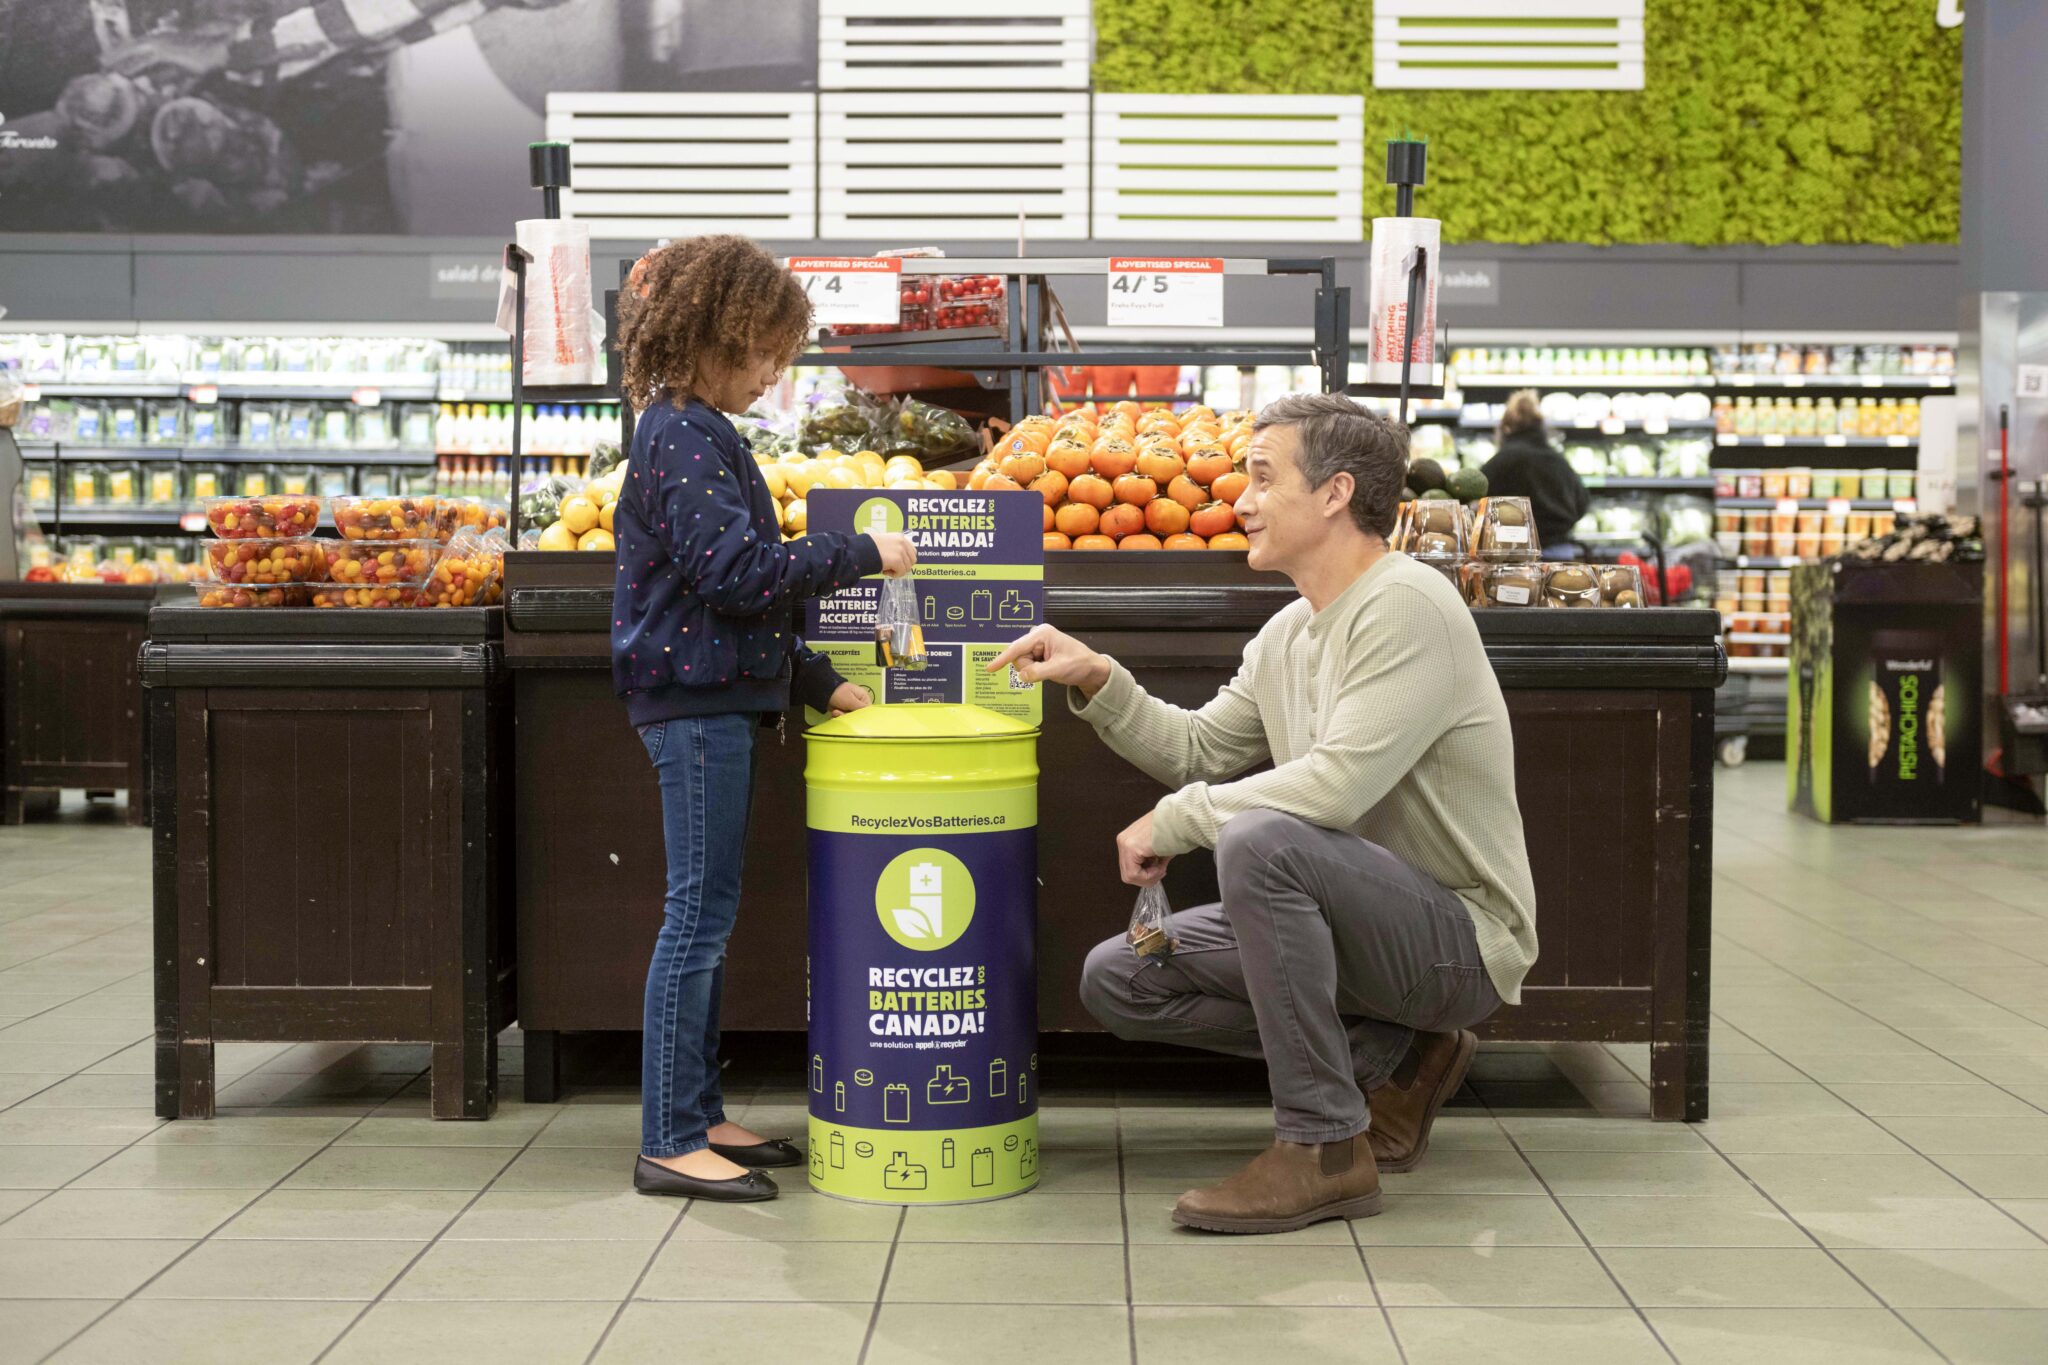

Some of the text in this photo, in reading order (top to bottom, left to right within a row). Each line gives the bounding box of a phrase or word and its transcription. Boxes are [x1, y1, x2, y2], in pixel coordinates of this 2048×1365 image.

[795, 260, 890, 269] ADVERTISED SPECIAL
[1116, 261, 1212, 269] ADVERTISED SPECIAL
[437, 264, 479, 282] salad
[908, 498, 986, 513] RECYCLEZ
[908, 515, 995, 530] BATTERIES
[909, 531, 995, 548] CANADA!
[911, 567, 977, 577] VosBatteries.ca
[835, 587, 878, 597] PILES ET
[819, 600, 878, 610] BATTERIES
[819, 611, 881, 624] ACCEPTÉES
[1884, 659, 1934, 671] Wonderful
[1899, 674, 1919, 780] PISTACHIOS
[850, 814, 1006, 830] RecyclezVosBatteries.ca
[868, 966, 975, 988] RECYCLEZ
[977, 965, 986, 985] VOS
[869, 988, 987, 1012] BATTERIES
[868, 1011, 986, 1037] CANADA!
[883, 1041, 914, 1049] solution
[915, 1040, 934, 1050] appel
[940, 1040, 967, 1050] recycler
